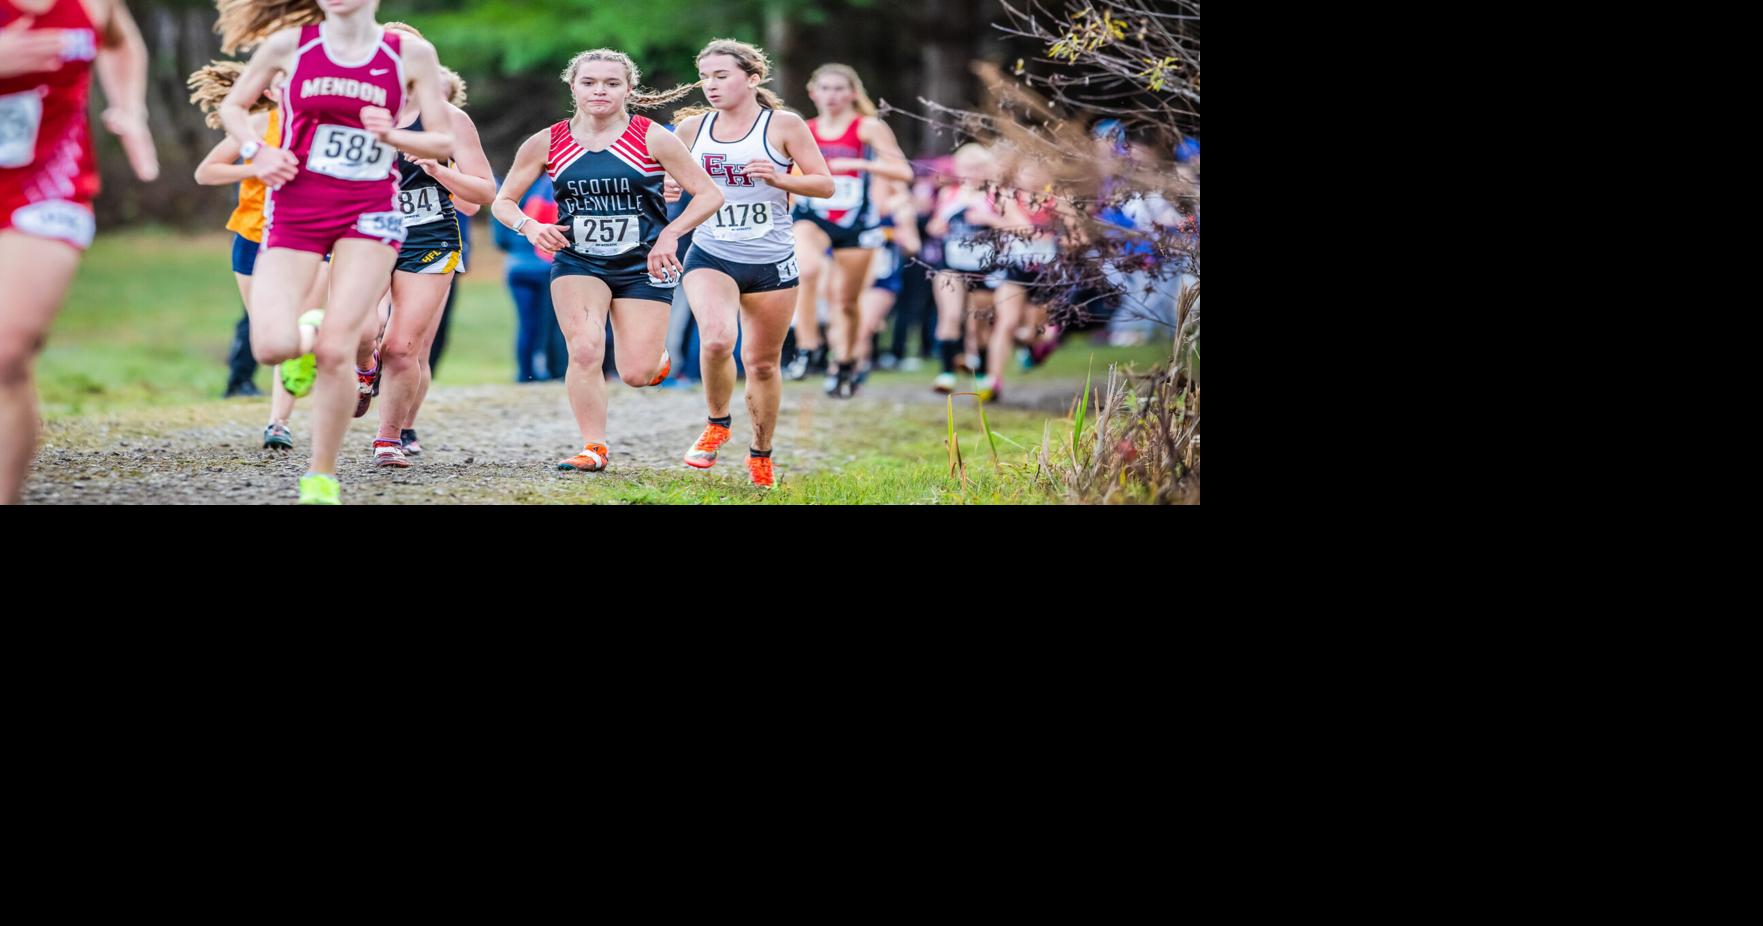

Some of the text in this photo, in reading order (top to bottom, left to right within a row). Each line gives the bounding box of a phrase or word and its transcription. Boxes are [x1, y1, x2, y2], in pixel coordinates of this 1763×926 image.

[300, 76, 387, 107] MENDON
[325, 131, 382, 164] 585
[567, 177, 630, 196] SCOTIA
[565, 194, 643, 213] GLENVILLE
[715, 202, 768, 228] 1178
[583, 218, 629, 243] 257
